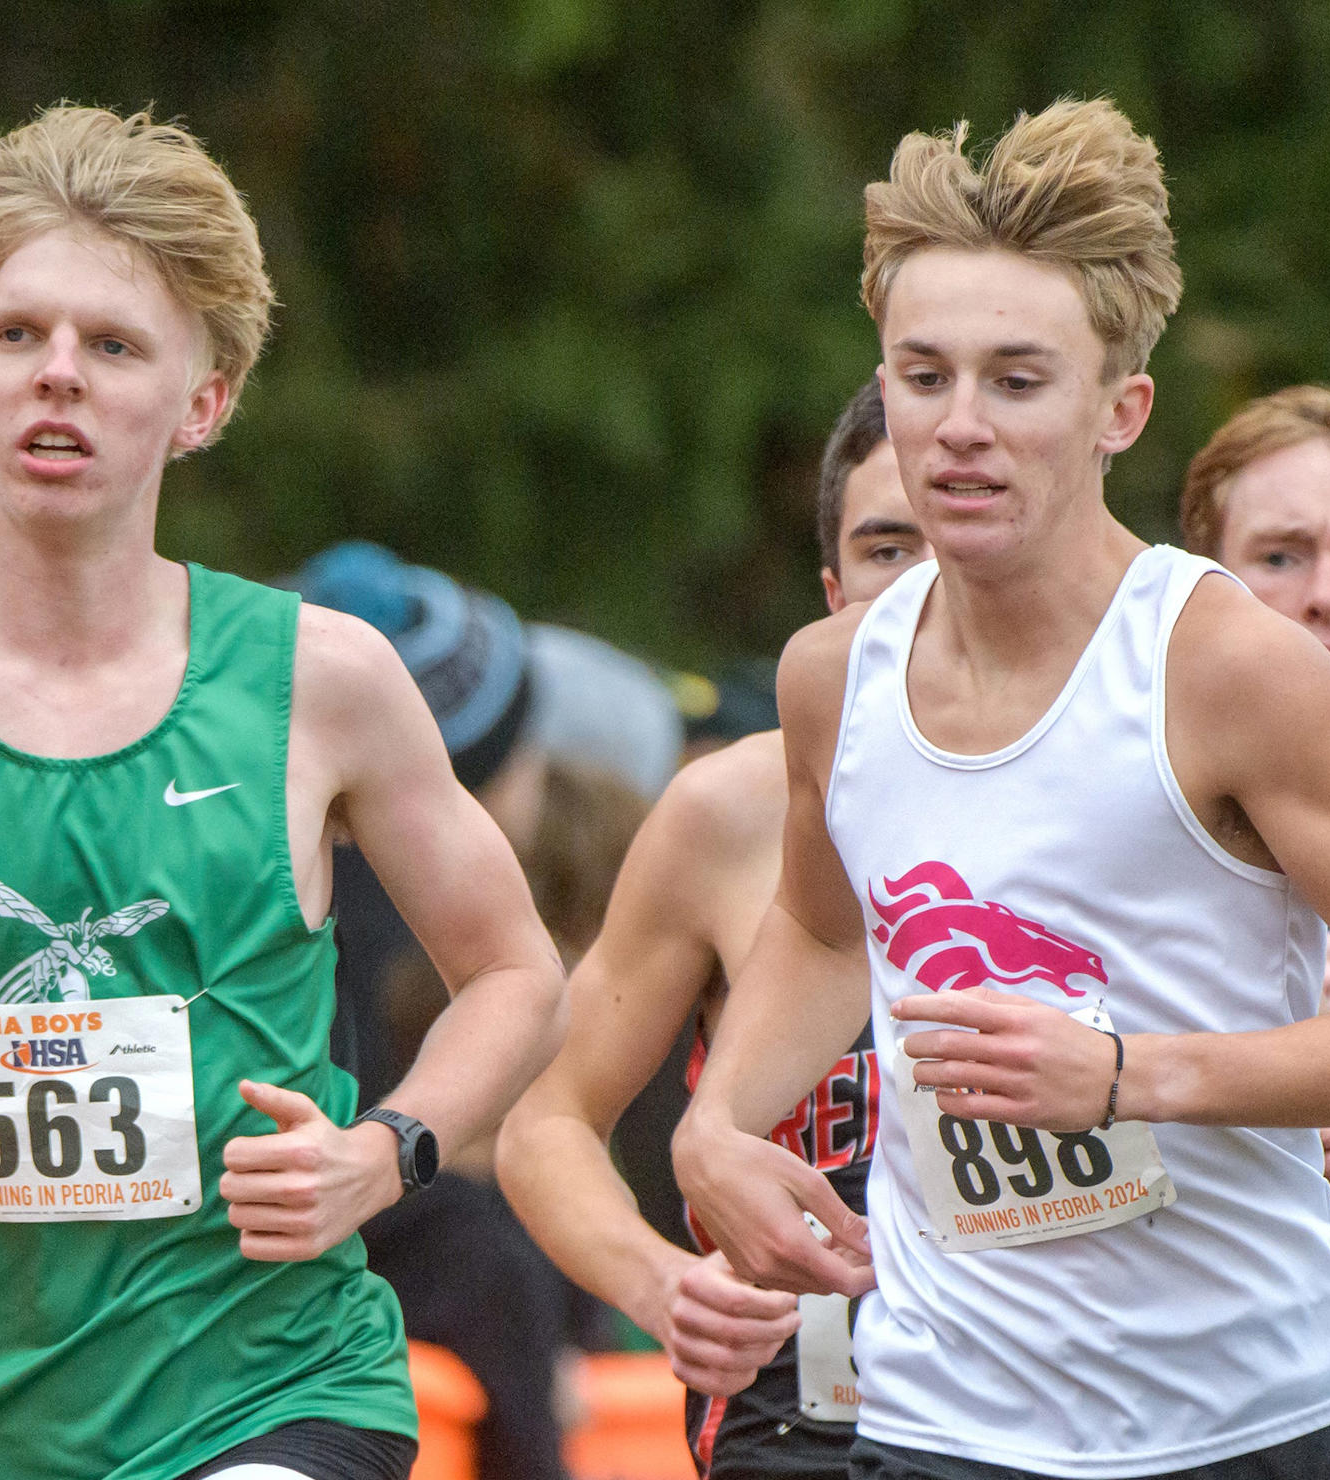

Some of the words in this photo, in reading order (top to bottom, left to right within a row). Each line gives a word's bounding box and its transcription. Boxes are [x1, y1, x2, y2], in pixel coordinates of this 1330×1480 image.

[30, 1012, 103, 1034] BOYS
[938, 1113, 1113, 1206] 898
[38, 1184, 56, 1206] IN
[61, 1181, 125, 1206] PEORIA
[130, 1179, 173, 1204] 2024
[954, 1207, 1021, 1236] RUNNING
[1021, 1205, 1042, 1227] IN
[1044, 1192, 1105, 1224] PEORIA
[1104, 1177, 1150, 1209] 2024
